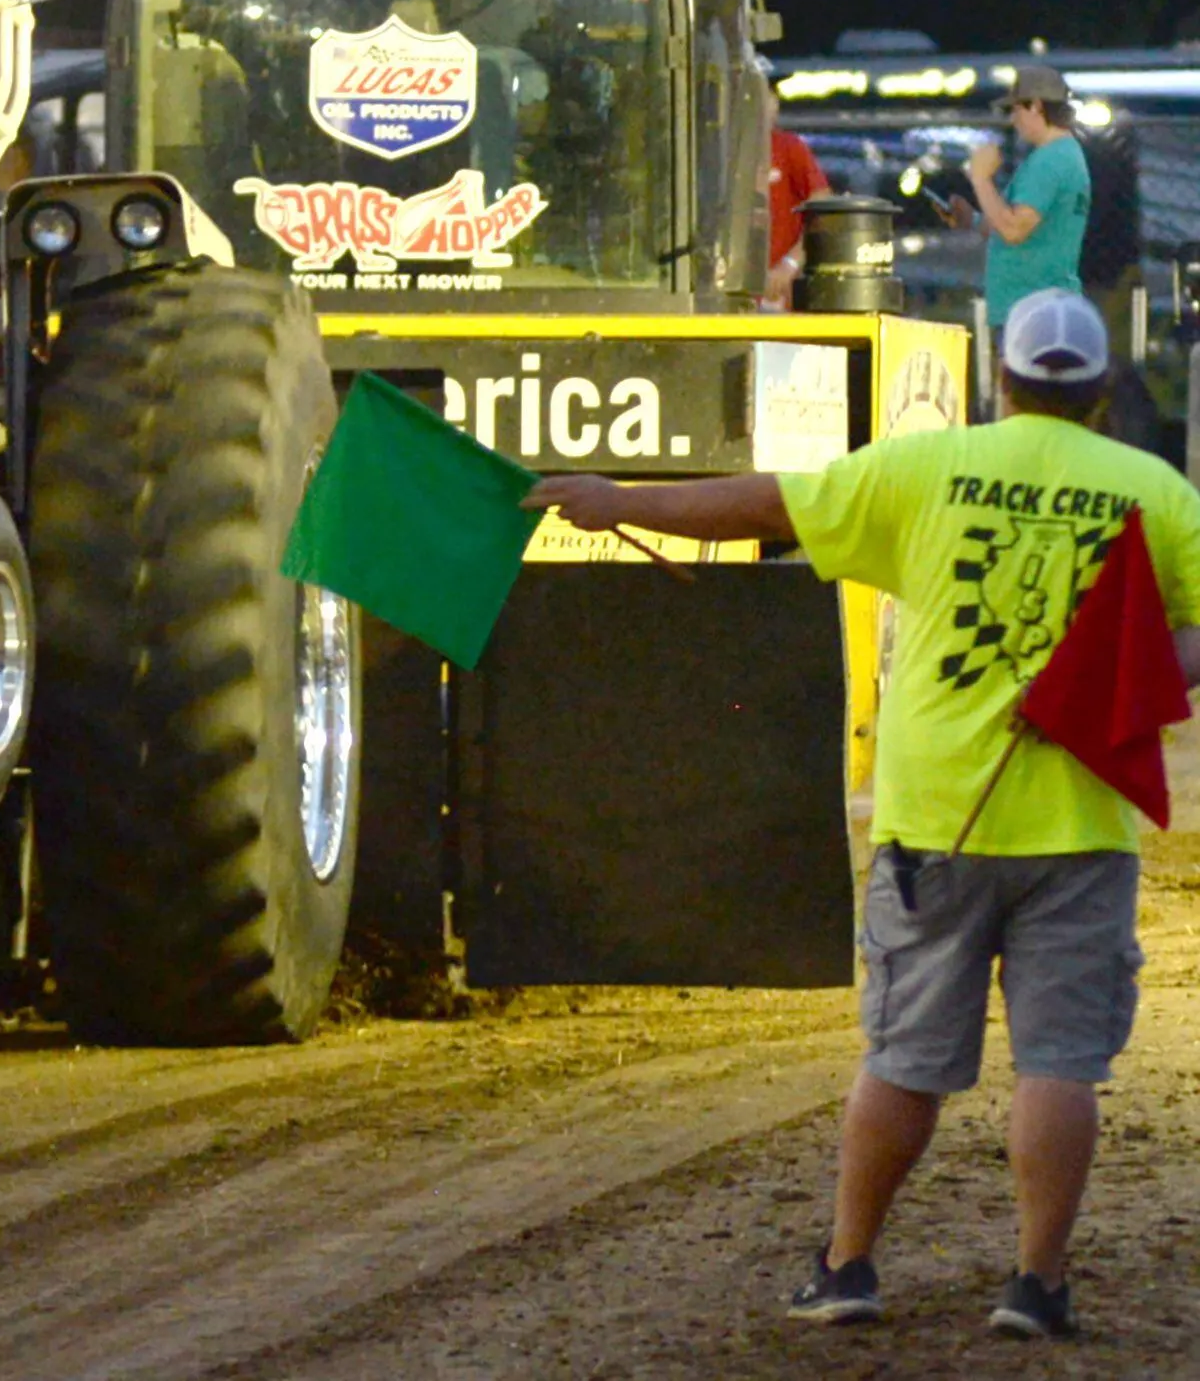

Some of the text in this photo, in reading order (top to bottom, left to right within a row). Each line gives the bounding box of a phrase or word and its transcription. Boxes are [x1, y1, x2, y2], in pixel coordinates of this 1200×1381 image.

[334, 65, 462, 95] LUCAS
[321, 103, 464, 121] OIL PRODUCTS
[373, 124, 413, 141] INC.
[288, 273, 504, 291] YOUR NEXT MOWER
[947, 476, 1140, 523] TRACK CREW
